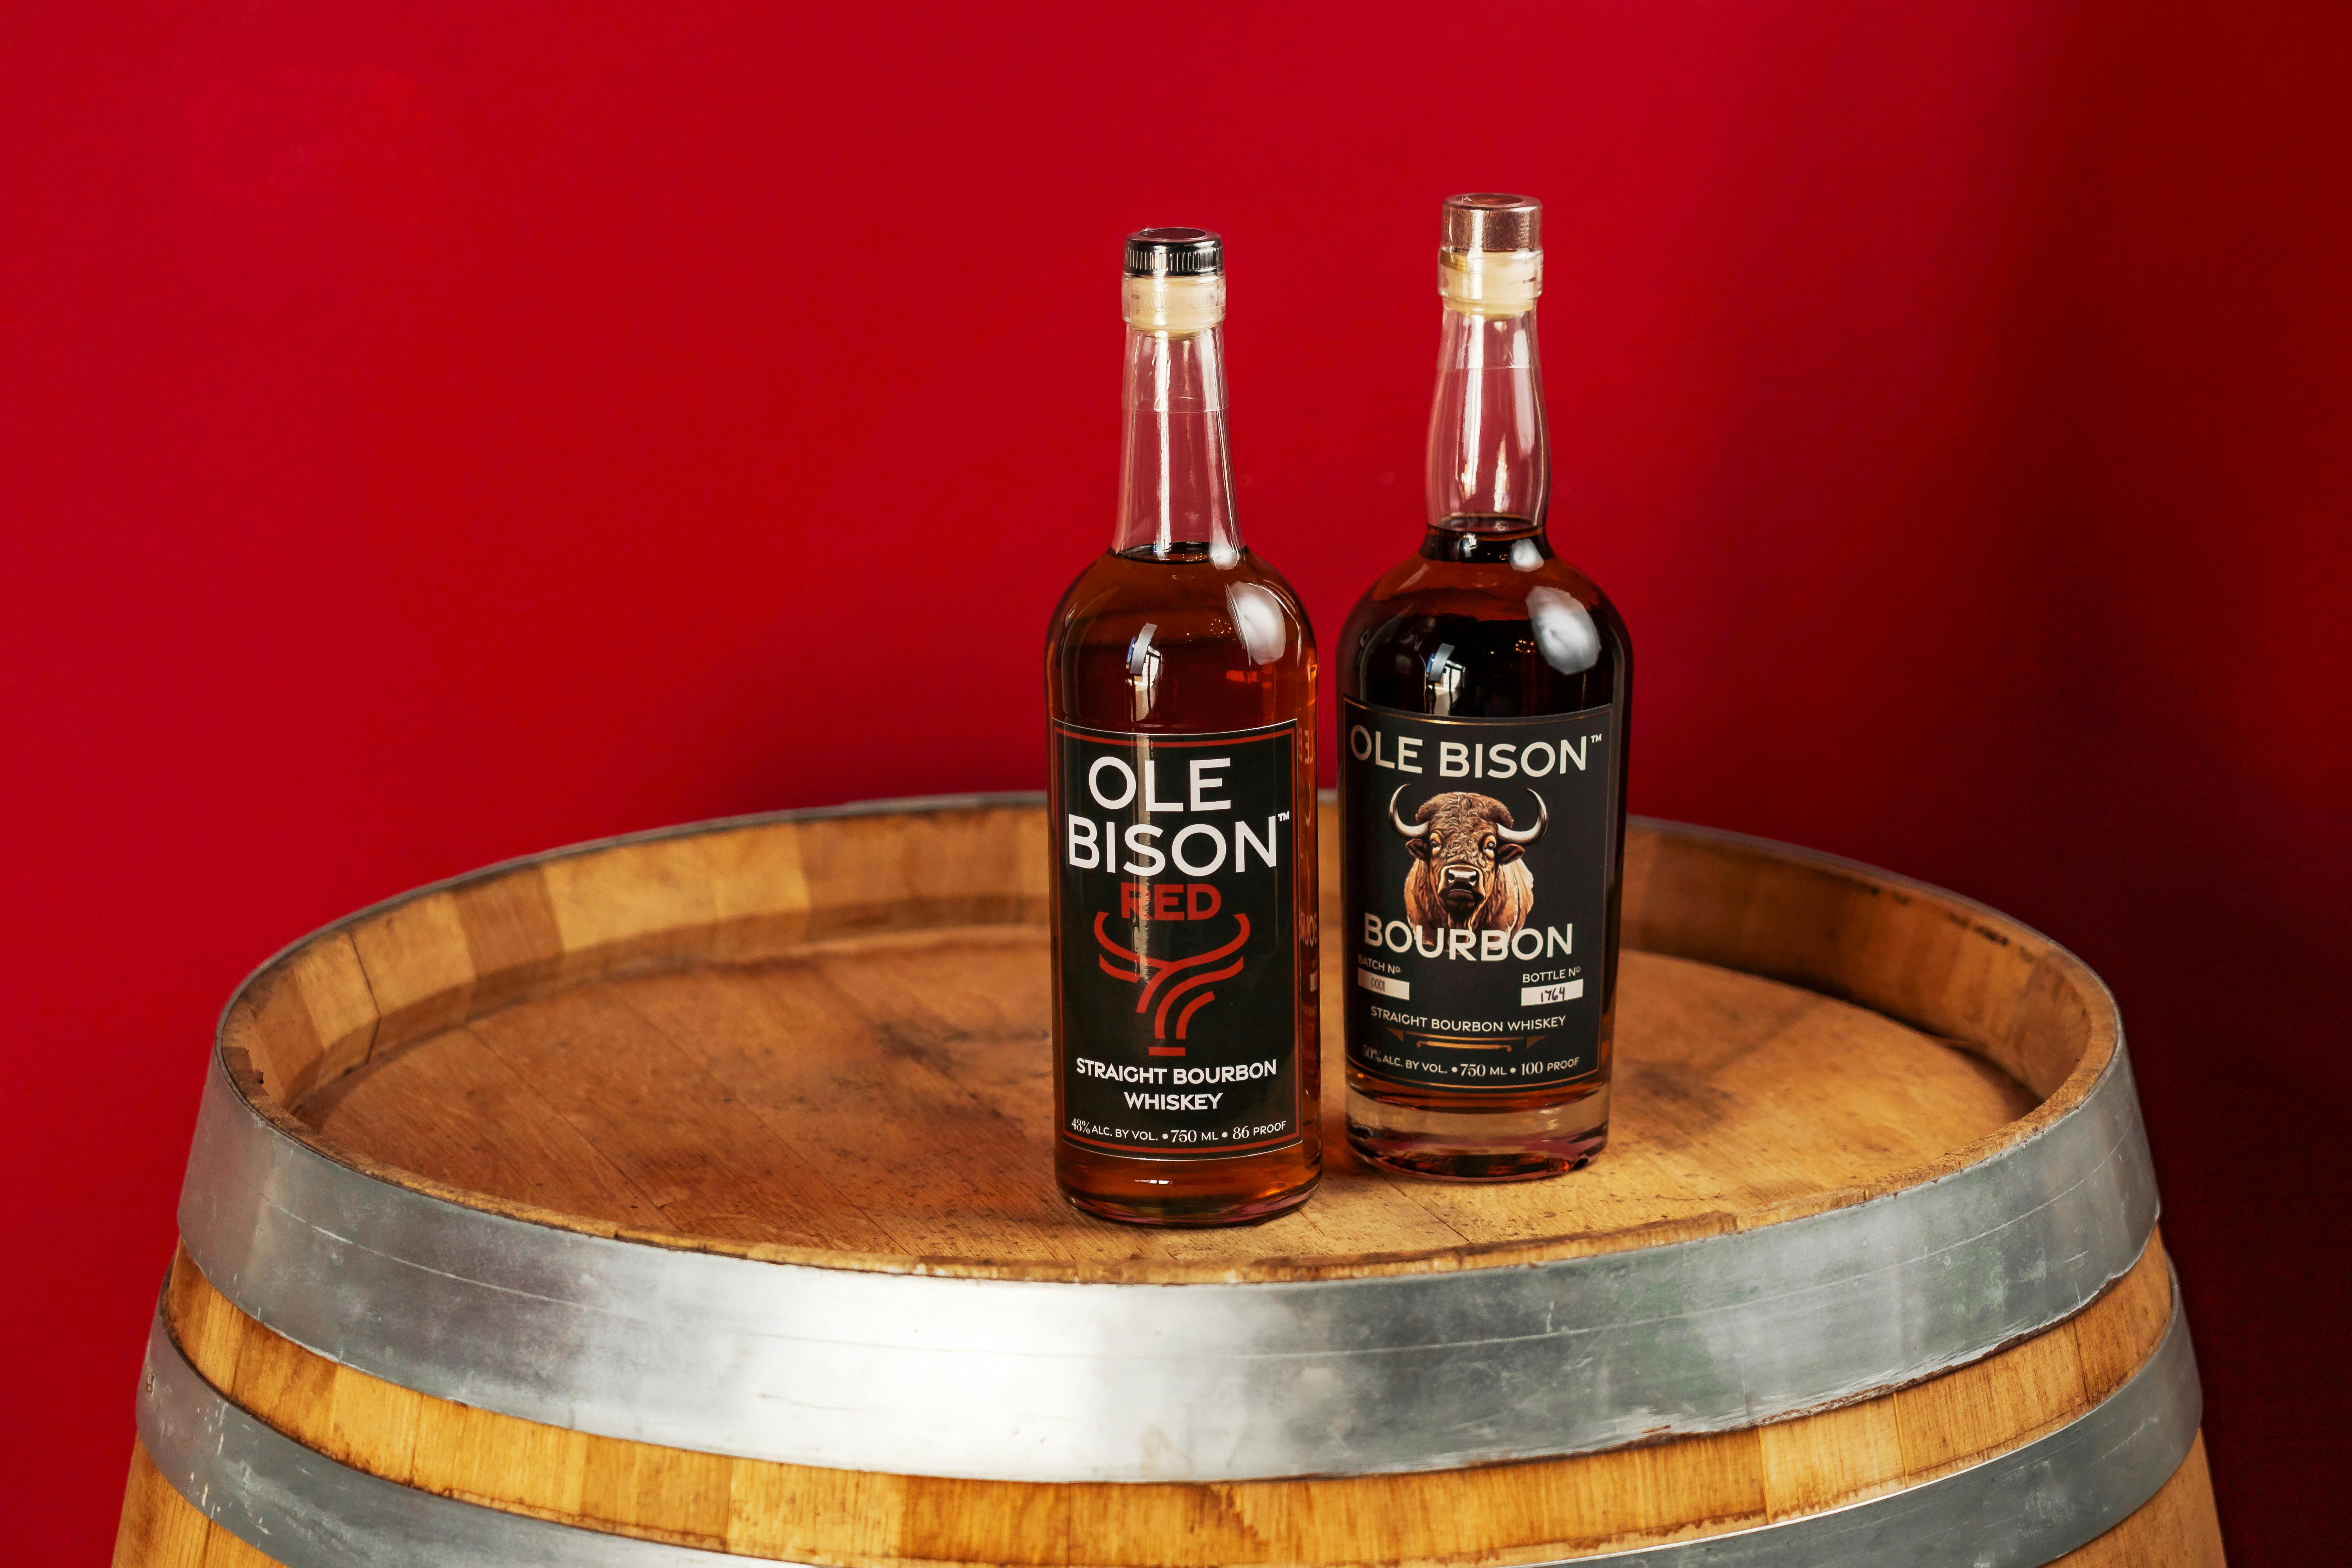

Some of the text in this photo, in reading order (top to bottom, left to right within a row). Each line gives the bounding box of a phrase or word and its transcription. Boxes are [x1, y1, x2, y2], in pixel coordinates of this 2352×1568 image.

[1350, 724, 1423, 774] OLE
[1089, 756, 1231, 812] OLE
[1120, 882, 1222, 921] RED
[1364, 912, 1573, 961] BOURBON
[1357, 953, 1386, 972] BATCH
[1523, 969, 1566, 982] BOTTLE
[1541, 986, 1565, 1003] 1764
[1372, 1006, 1566, 1032] STRAIGHT BOURBON WHISKEY
[1076, 1057, 1276, 1084] STRAIGHT BOURBON
[1382, 1055, 1403, 1066] ALC.
[1405, 1060, 1419, 1069] BY
[1421, 1062, 1448, 1074] VOL.
[1460, 1063, 1486, 1076] 750
[1490, 1067, 1507, 1075] ML
[1521, 1061, 1543, 1076] 100
[1547, 1057, 1579, 1072] PROOF
[1123, 1091, 1223, 1111] WHISKEY
[1091, 1124, 1112, 1136] ALC.
[1115, 1129, 1129, 1138] BY
[1131, 1130, 1158, 1141] VOL.
[1171, 1130, 1197, 1143] 750
[1201, 1131, 1219, 1141] ML
[1232, 1125, 1250, 1140] 86
[1253, 1120, 1287, 1136] PROOF
